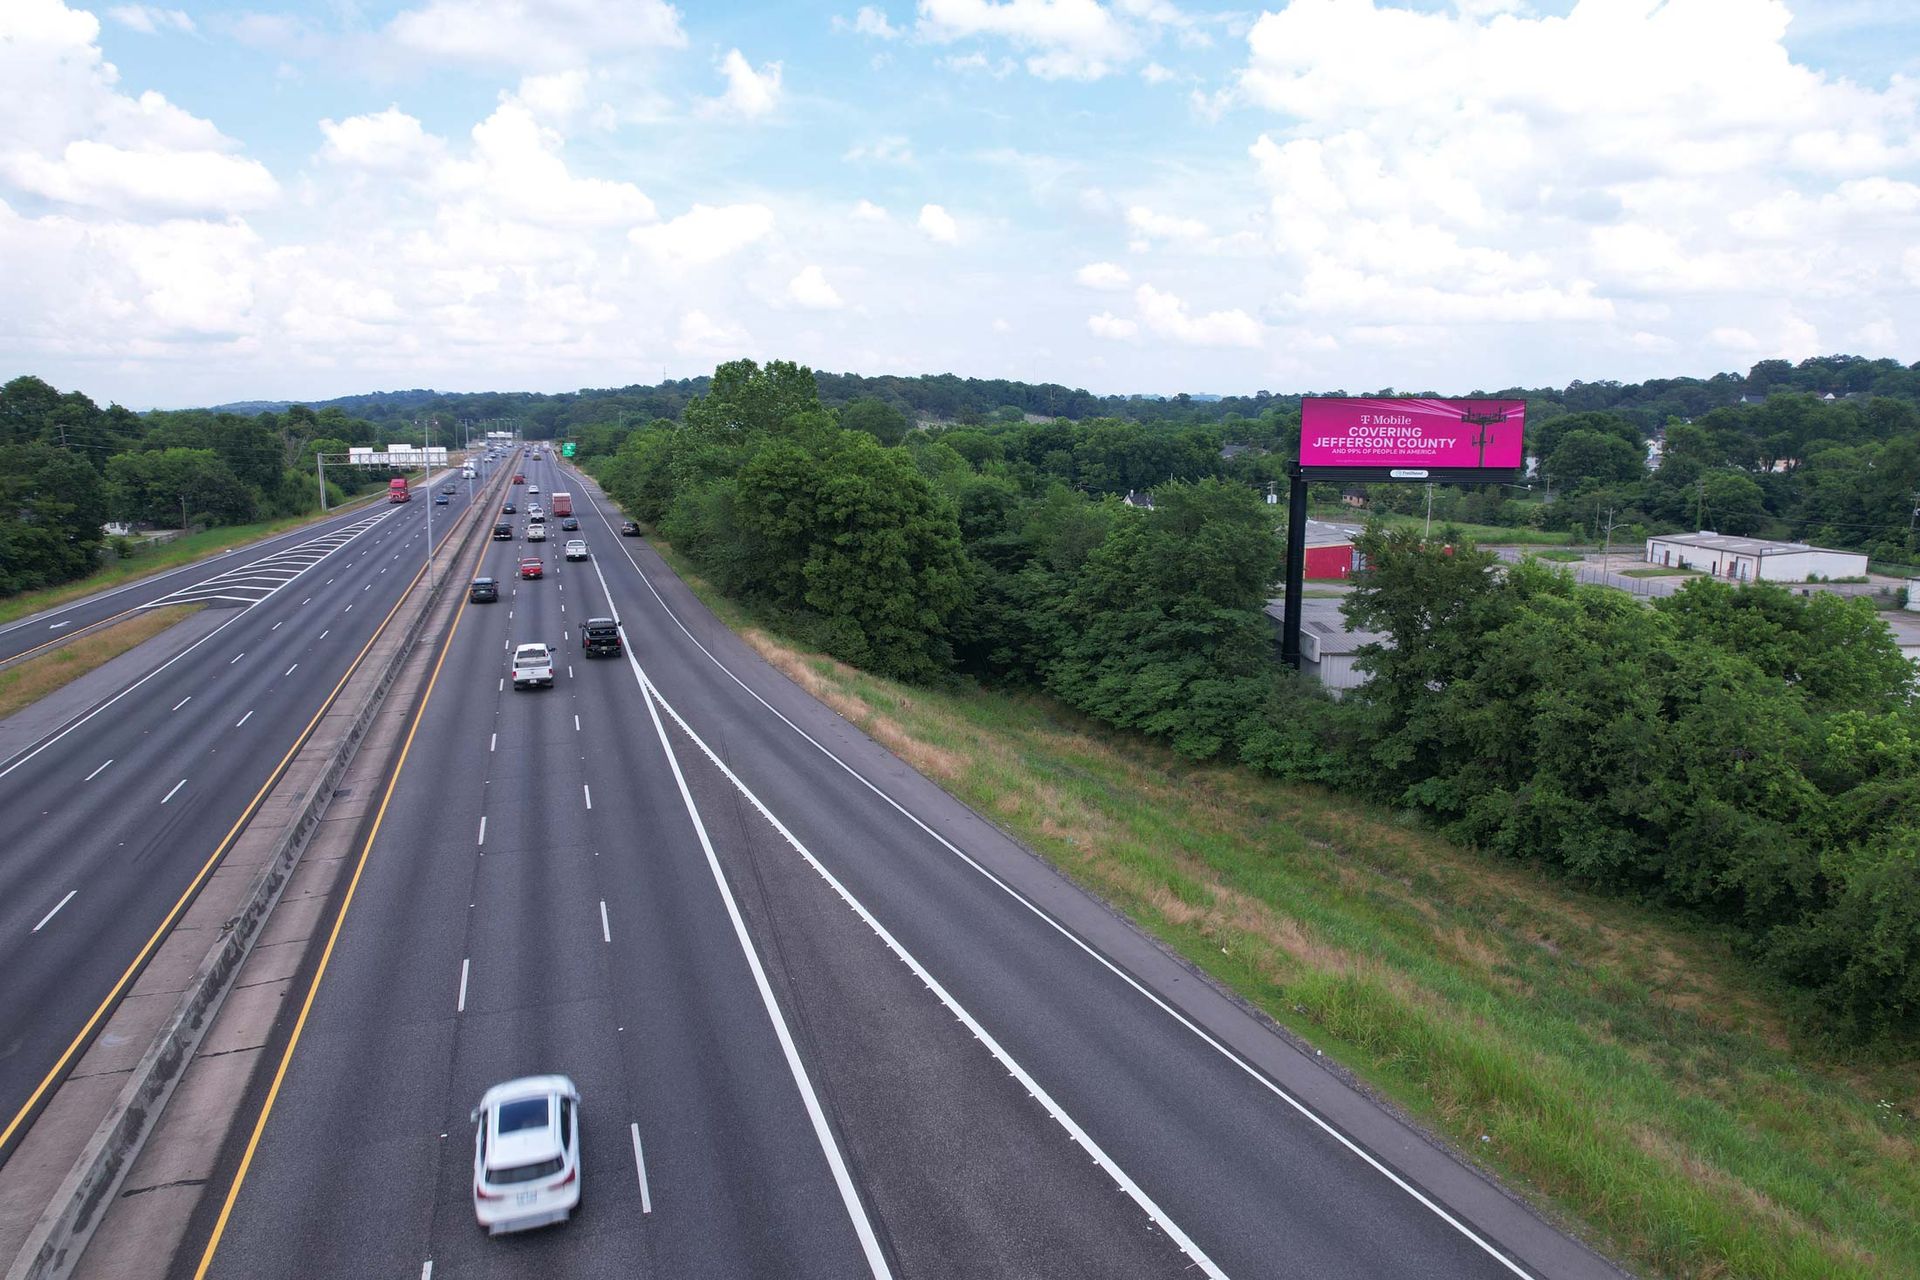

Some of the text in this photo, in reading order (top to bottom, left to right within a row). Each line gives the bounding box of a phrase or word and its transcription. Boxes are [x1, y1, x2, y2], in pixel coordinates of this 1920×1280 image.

[1373, 414, 1412, 425] Mobile
[1348, 426, 1422, 438] COVERING
[1312, 437, 1456, 449] JEFFERSON COUNTY
